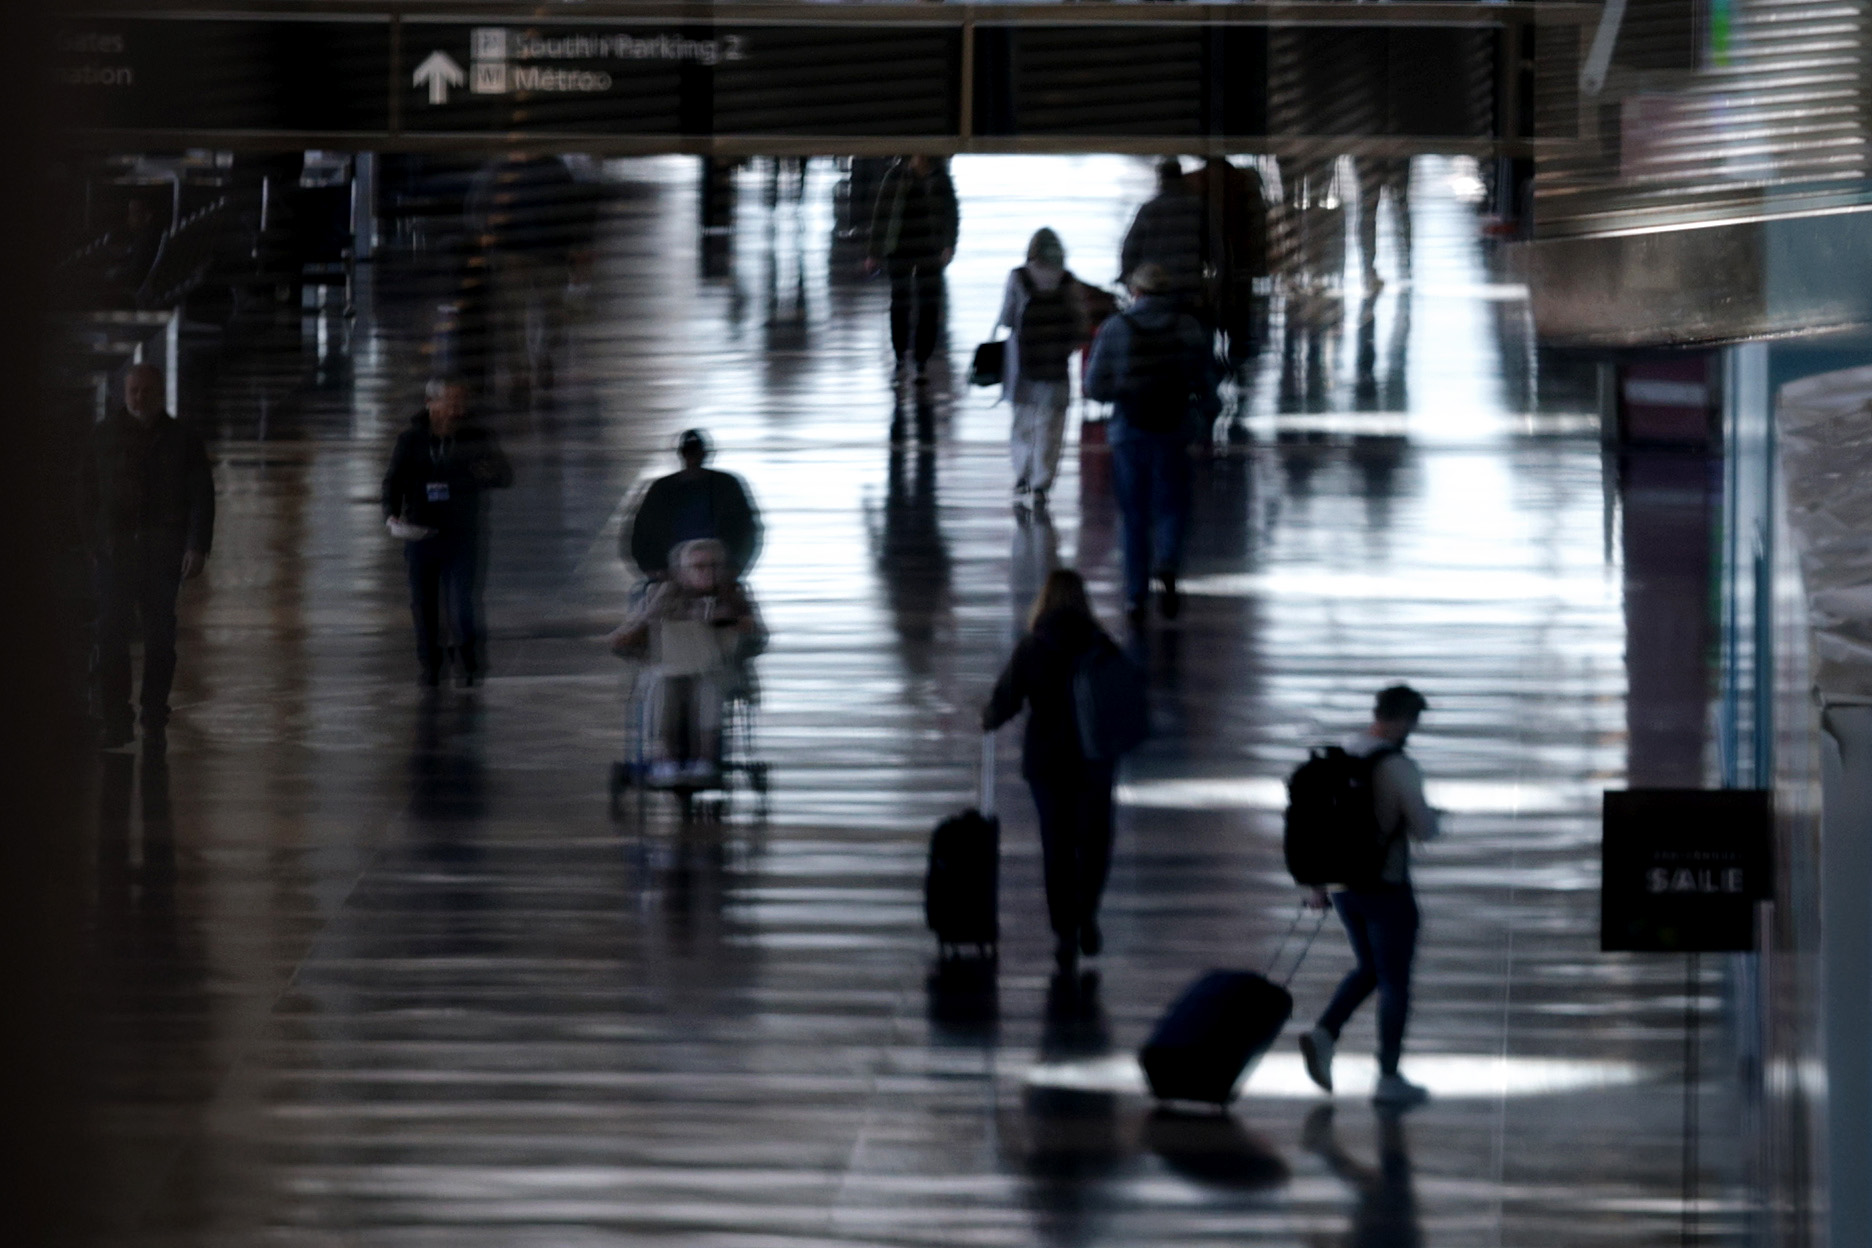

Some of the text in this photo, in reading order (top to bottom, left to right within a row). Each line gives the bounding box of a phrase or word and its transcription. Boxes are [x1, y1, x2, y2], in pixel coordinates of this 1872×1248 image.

[514, 33, 593, 60] South
[612, 33, 720, 66] Parking
[722, 33, 748, 61] 2
[514, 68, 613, 92] Metro
[1643, 865, 1745, 896] SALE
